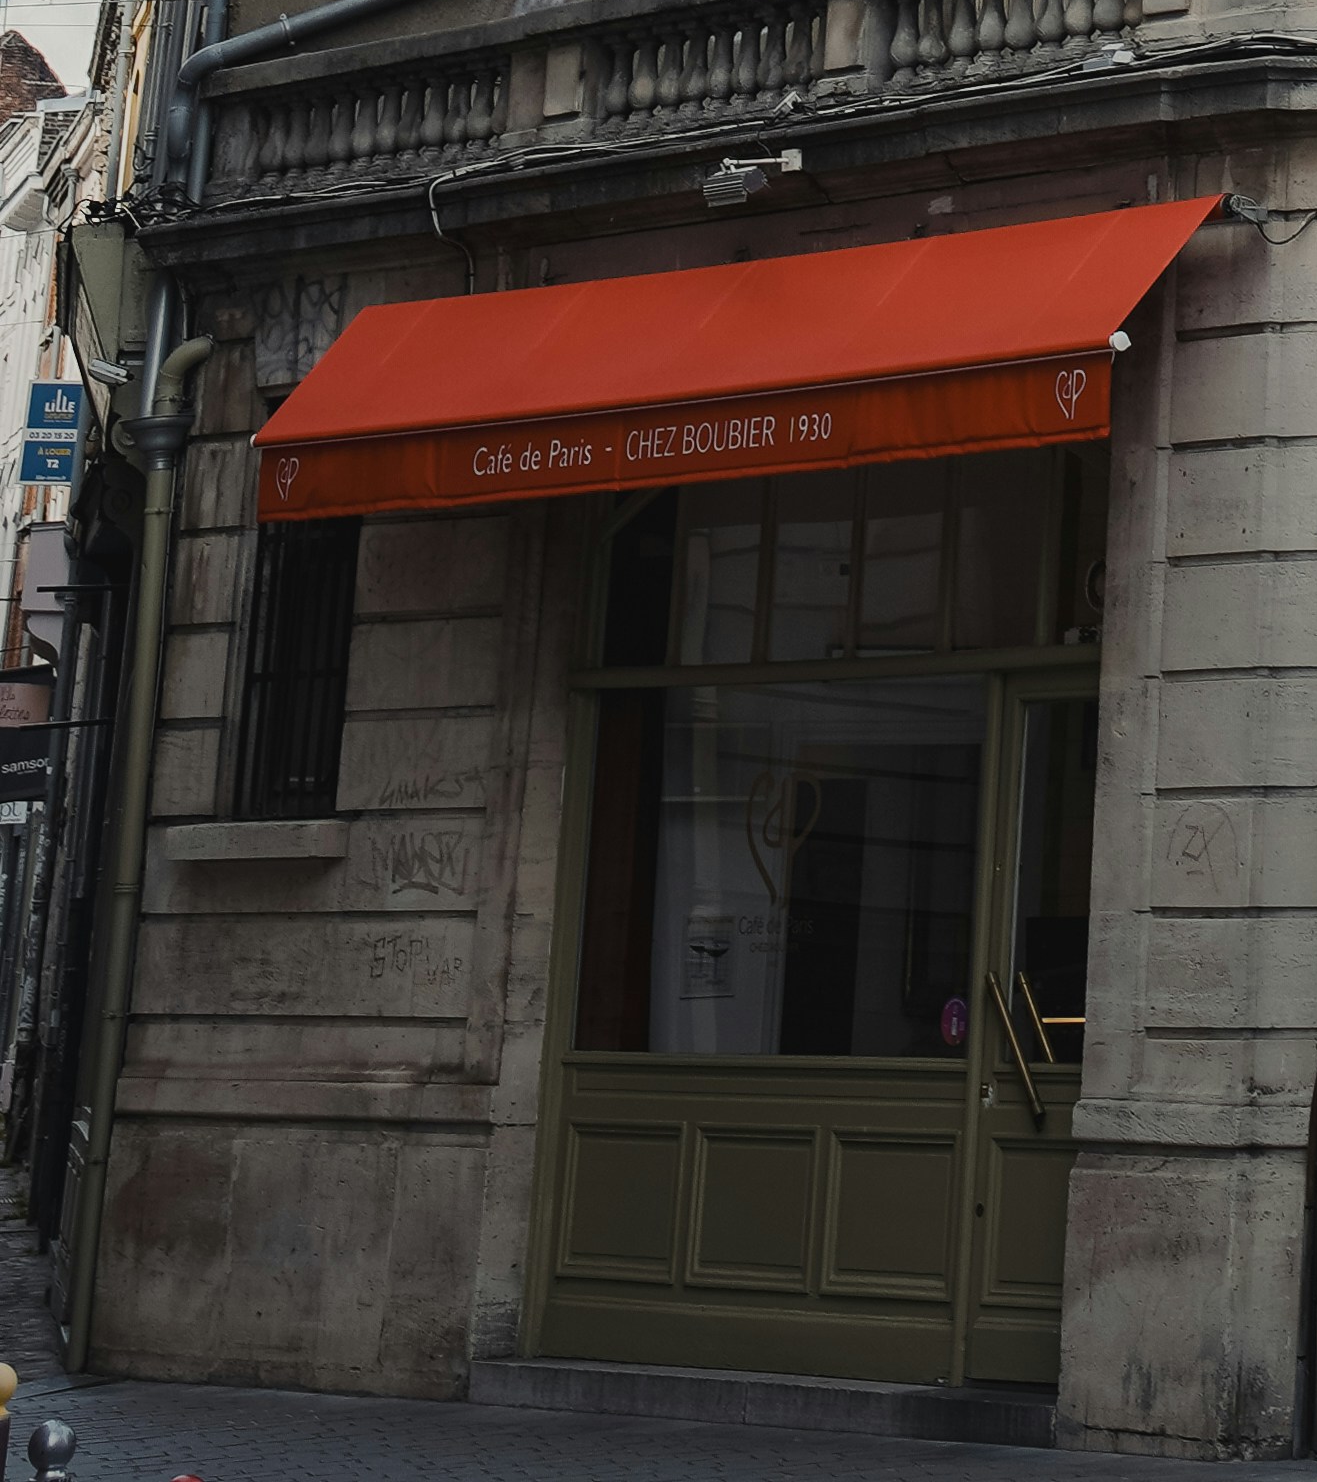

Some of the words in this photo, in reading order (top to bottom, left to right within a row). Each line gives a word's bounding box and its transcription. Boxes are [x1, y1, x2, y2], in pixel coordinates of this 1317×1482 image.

[473, 443, 511, 476] Café
[519, 442, 541, 471] de
[549, 438, 592, 468] Paris
[626, 426, 676, 461] CHEZ
[682, 416, 775, 454] BOUBIER
[789, 412, 831, 443] 1930
